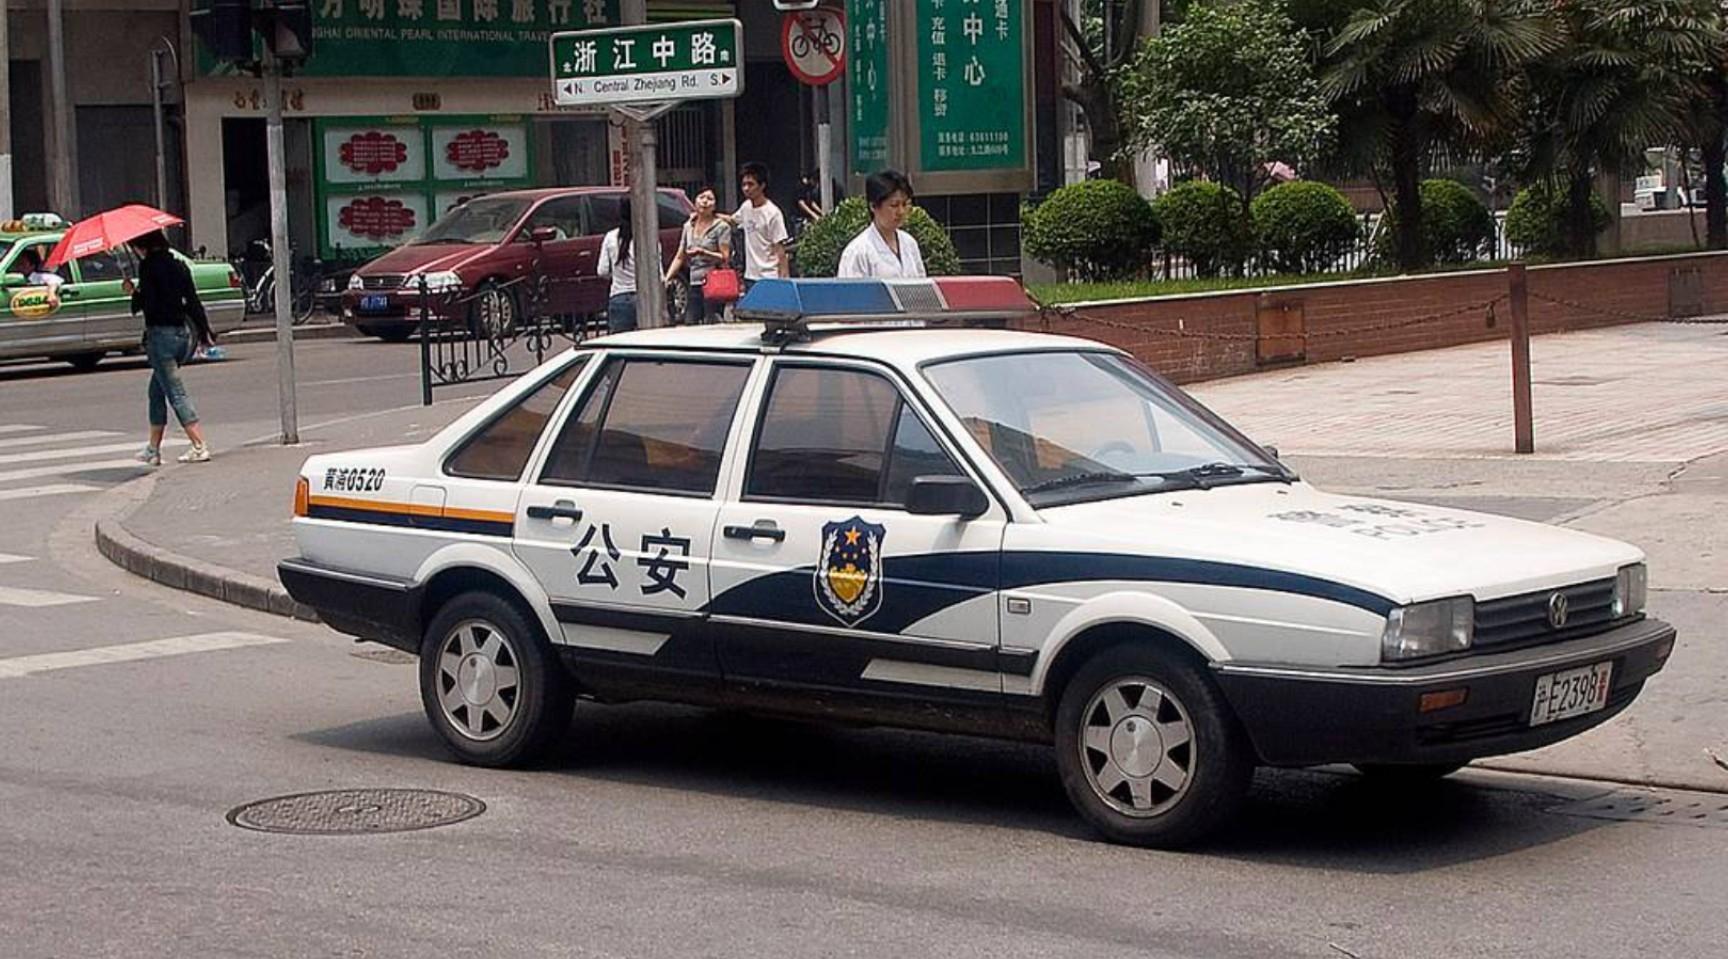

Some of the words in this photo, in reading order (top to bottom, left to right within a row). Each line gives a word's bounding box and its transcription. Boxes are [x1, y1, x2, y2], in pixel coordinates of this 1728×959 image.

[345, 27, 398, 40] ORIENTAL
[400, 28, 434, 41] PEARL
[437, 29, 514, 42] INTERNATIONAL
[518, 30, 550, 42] TRAVE
[573, 32, 717, 73] 浙江中路
[963, 0, 987, 86] 中心
[594, 78, 629, 93] Central
[634, 77, 676, 92] Zhejiang
[682, 74, 699, 88] Rd.
[710, 73, 721, 87] S.
[570, 523, 691, 600] 公安
